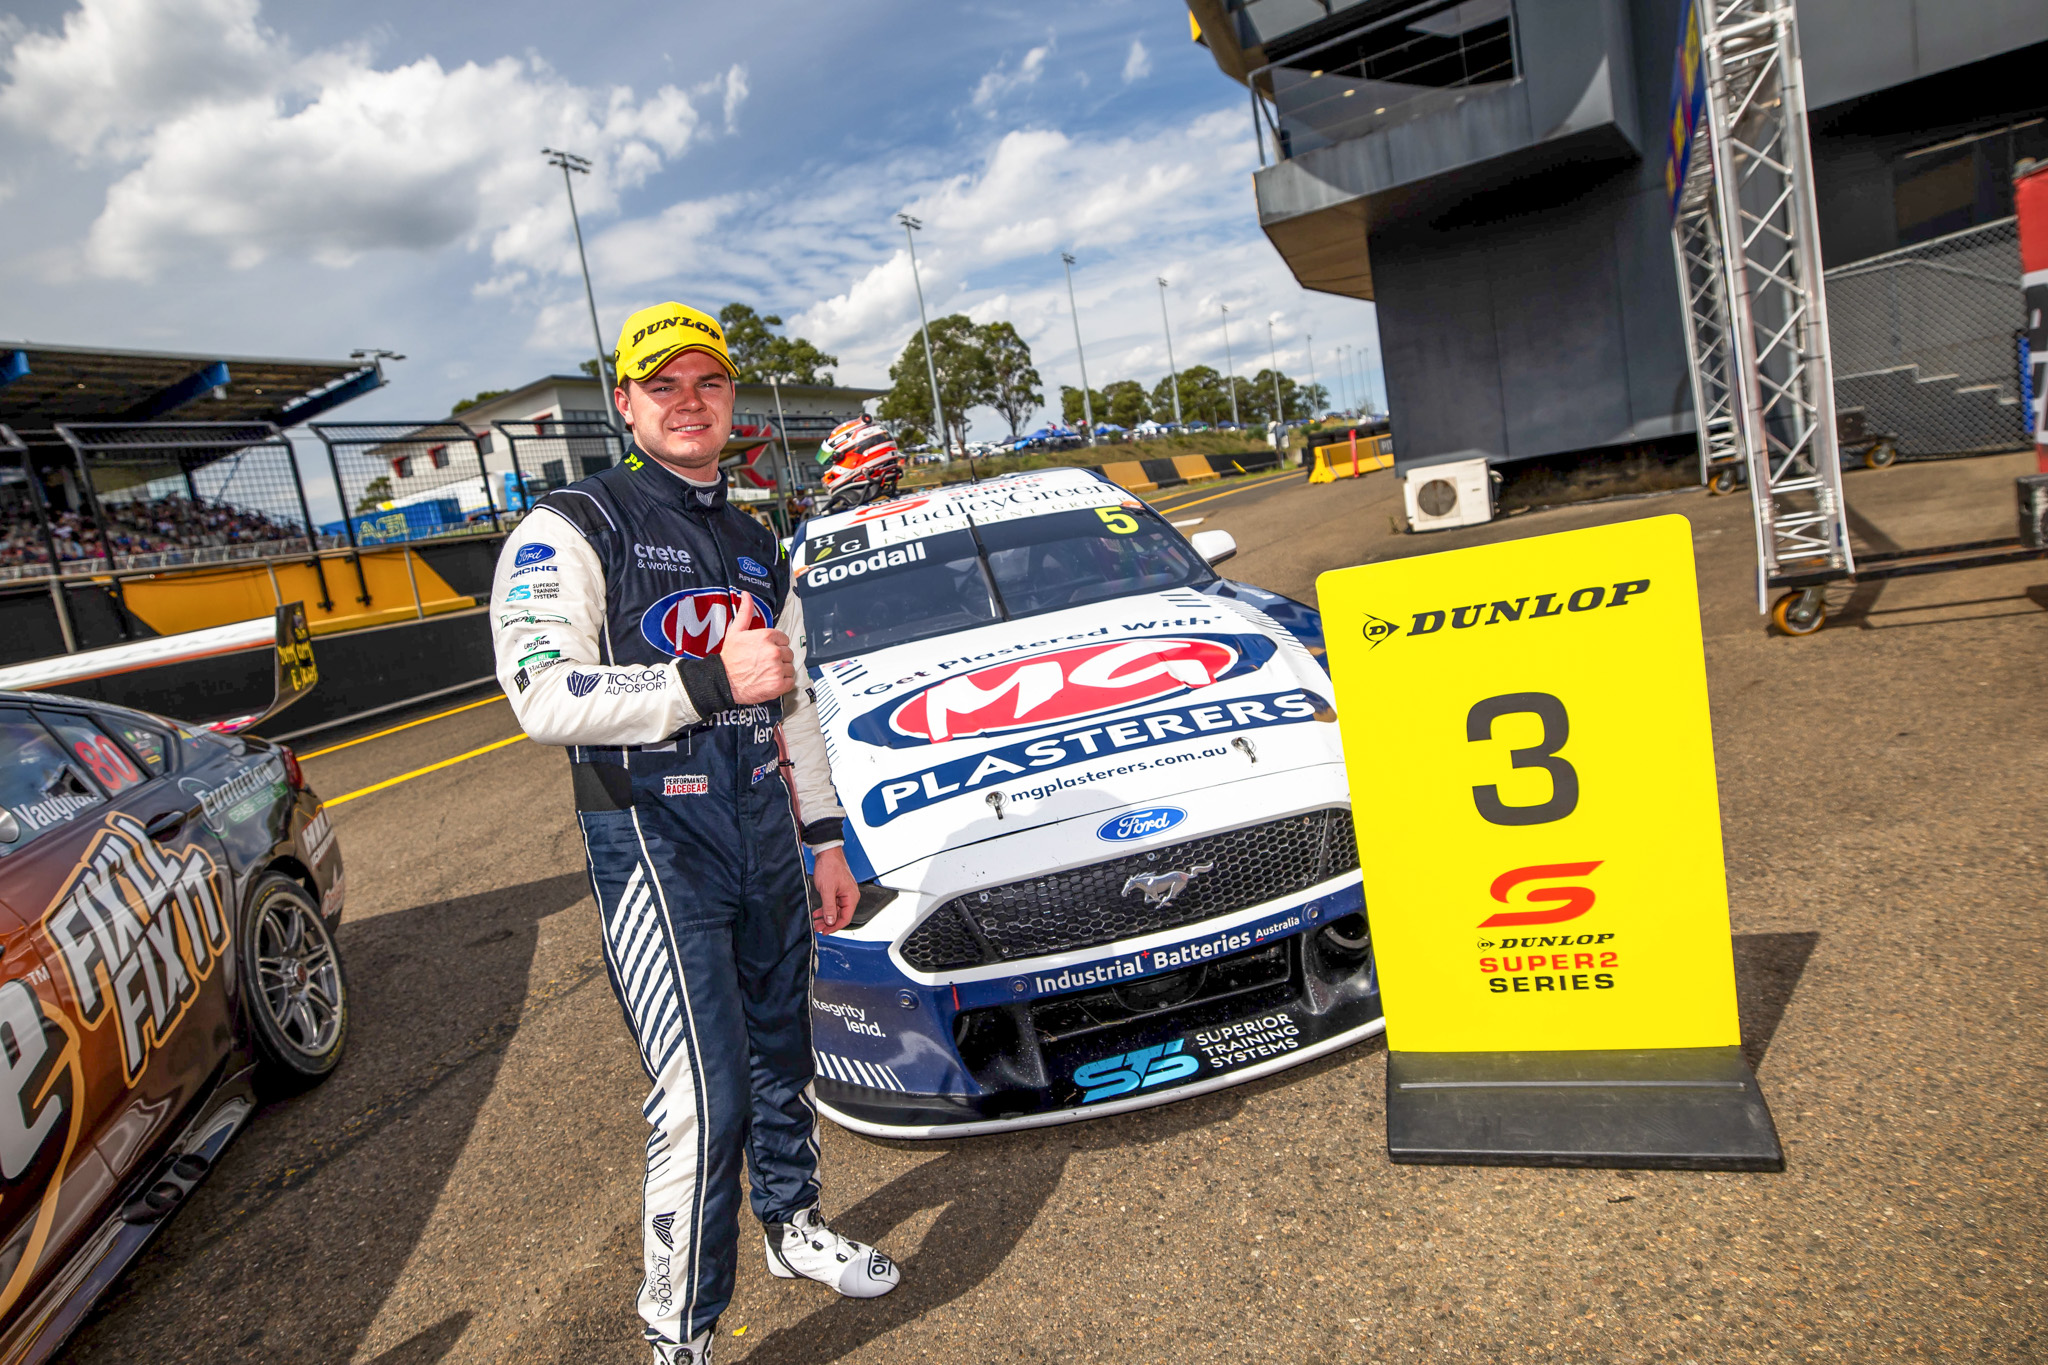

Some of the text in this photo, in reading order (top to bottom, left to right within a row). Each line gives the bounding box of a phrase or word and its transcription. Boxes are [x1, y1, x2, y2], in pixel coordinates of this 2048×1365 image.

[632, 316, 720, 347] DUNLOP
[880, 482, 1116, 532] HadleyGreen
[951, 484, 1040, 501] SERIES
[1094, 506, 1139, 534] 5
[517, 547, 542, 564] Ford
[634, 543, 691, 563] crete
[637, 559, 694, 574] & works co.
[742, 558, 762, 575] Ford
[807, 542, 927, 588] Goodall
[510, 565, 558, 580] RACING
[738, 573, 772, 588] RACING
[1406, 578, 1651, 637] DUNLOP
[937, 627, 1109, 670] Plastered
[926, 641, 1212, 741] MG
[753, 725, 773, 745] len
[74, 735, 139, 790] 80
[881, 694, 1315, 815] PLASTERERS
[1466, 691, 1579, 826] 3
[666, 777, 707, 785] PERFORMANCE
[1011, 745, 1228, 802] mgplasterers.com.au
[194, 766, 276, 819] Evolution
[666, 783, 707, 794] RACEGEAR
[1116, 811, 1170, 838] Ford
[1036, 916, 1300, 993] Industrial Batteries Australia
[1499, 933, 1615, 949] DUNLOP
[27, 966, 51, 987] TM
[114, 852, 220, 1073] FIX IT
[1479, 952, 1619, 973] SUPER2
[1489, 973, 1615, 993] SERIES
[844, 1017, 886, 1037] lend.
[1196, 1013, 1293, 1046] SUPERIOR
[1201, 1025, 1300, 1057] TRAINING
[1210, 1038, 1299, 1068] SYSTEMS
[656, 1254, 671, 1317] TICKFORD
